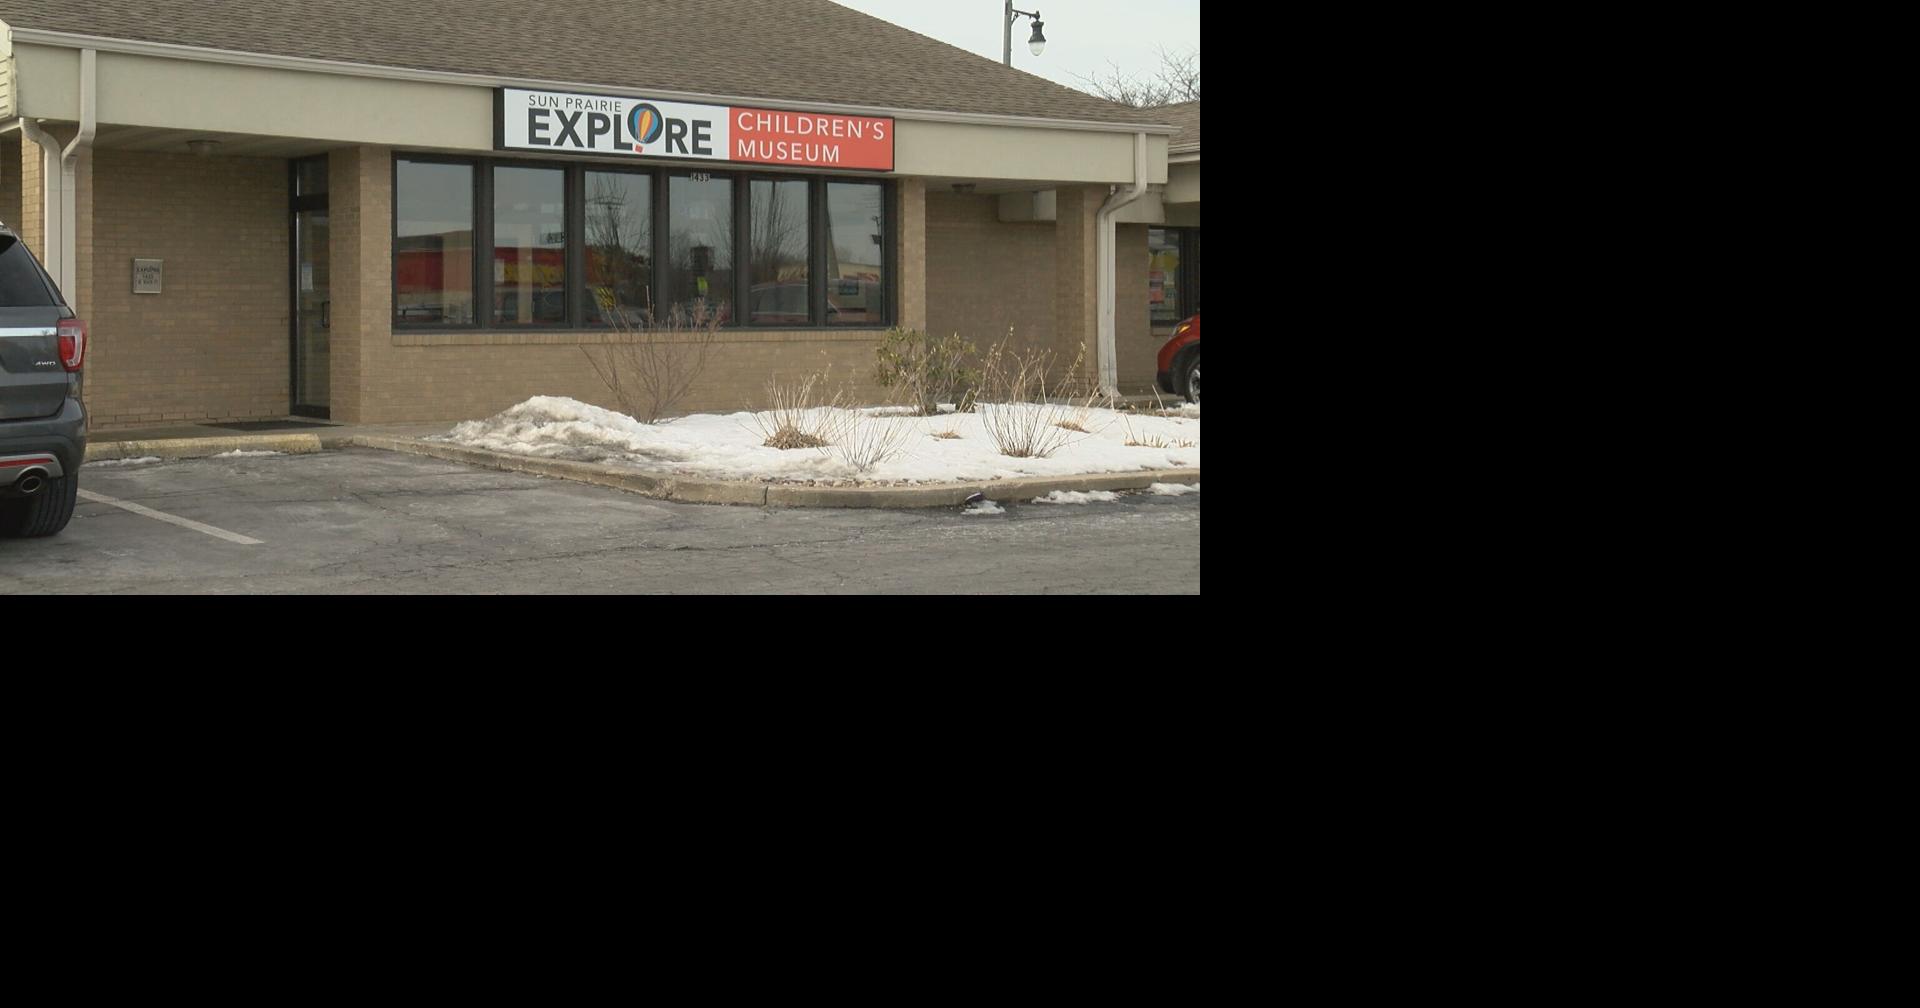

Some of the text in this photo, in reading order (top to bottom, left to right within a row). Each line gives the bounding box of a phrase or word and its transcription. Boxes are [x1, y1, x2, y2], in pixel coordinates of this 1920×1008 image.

[528, 94, 622, 113] SUN PRAIRIE
[528, 103, 713, 156] EXPLORE
[737, 112, 885, 140] CHILDREN'S
[737, 139, 840, 163] MUSEUM
